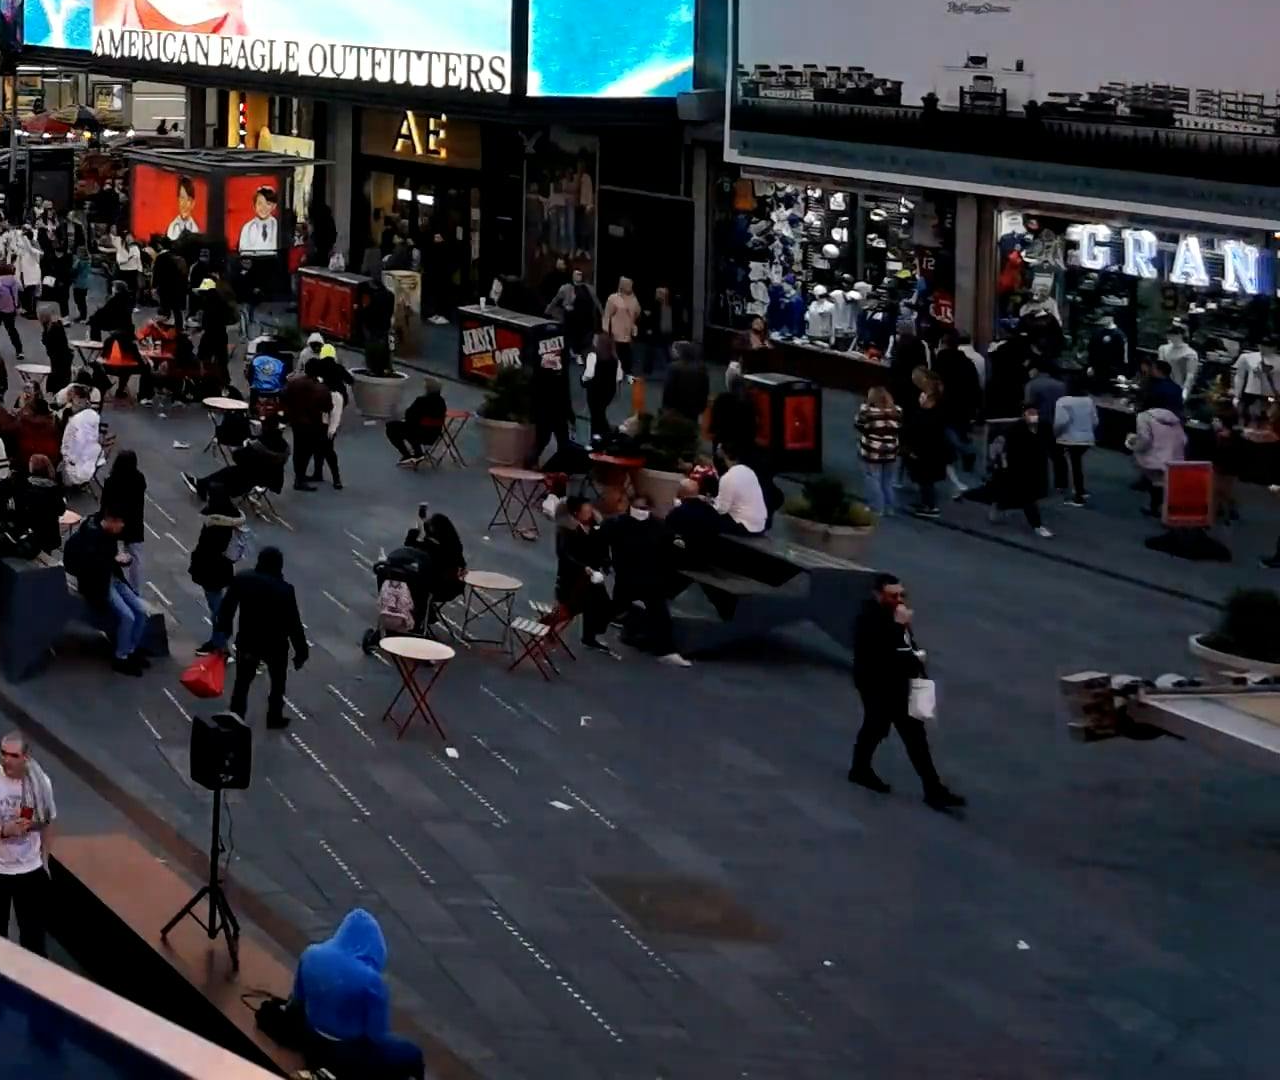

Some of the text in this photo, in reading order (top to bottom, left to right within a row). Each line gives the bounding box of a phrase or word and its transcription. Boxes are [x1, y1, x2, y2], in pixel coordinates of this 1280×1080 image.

[95, 31, 506, 93] AMERICAN EAGLE OUTFITTERS
[393, 110, 447, 158] AE
